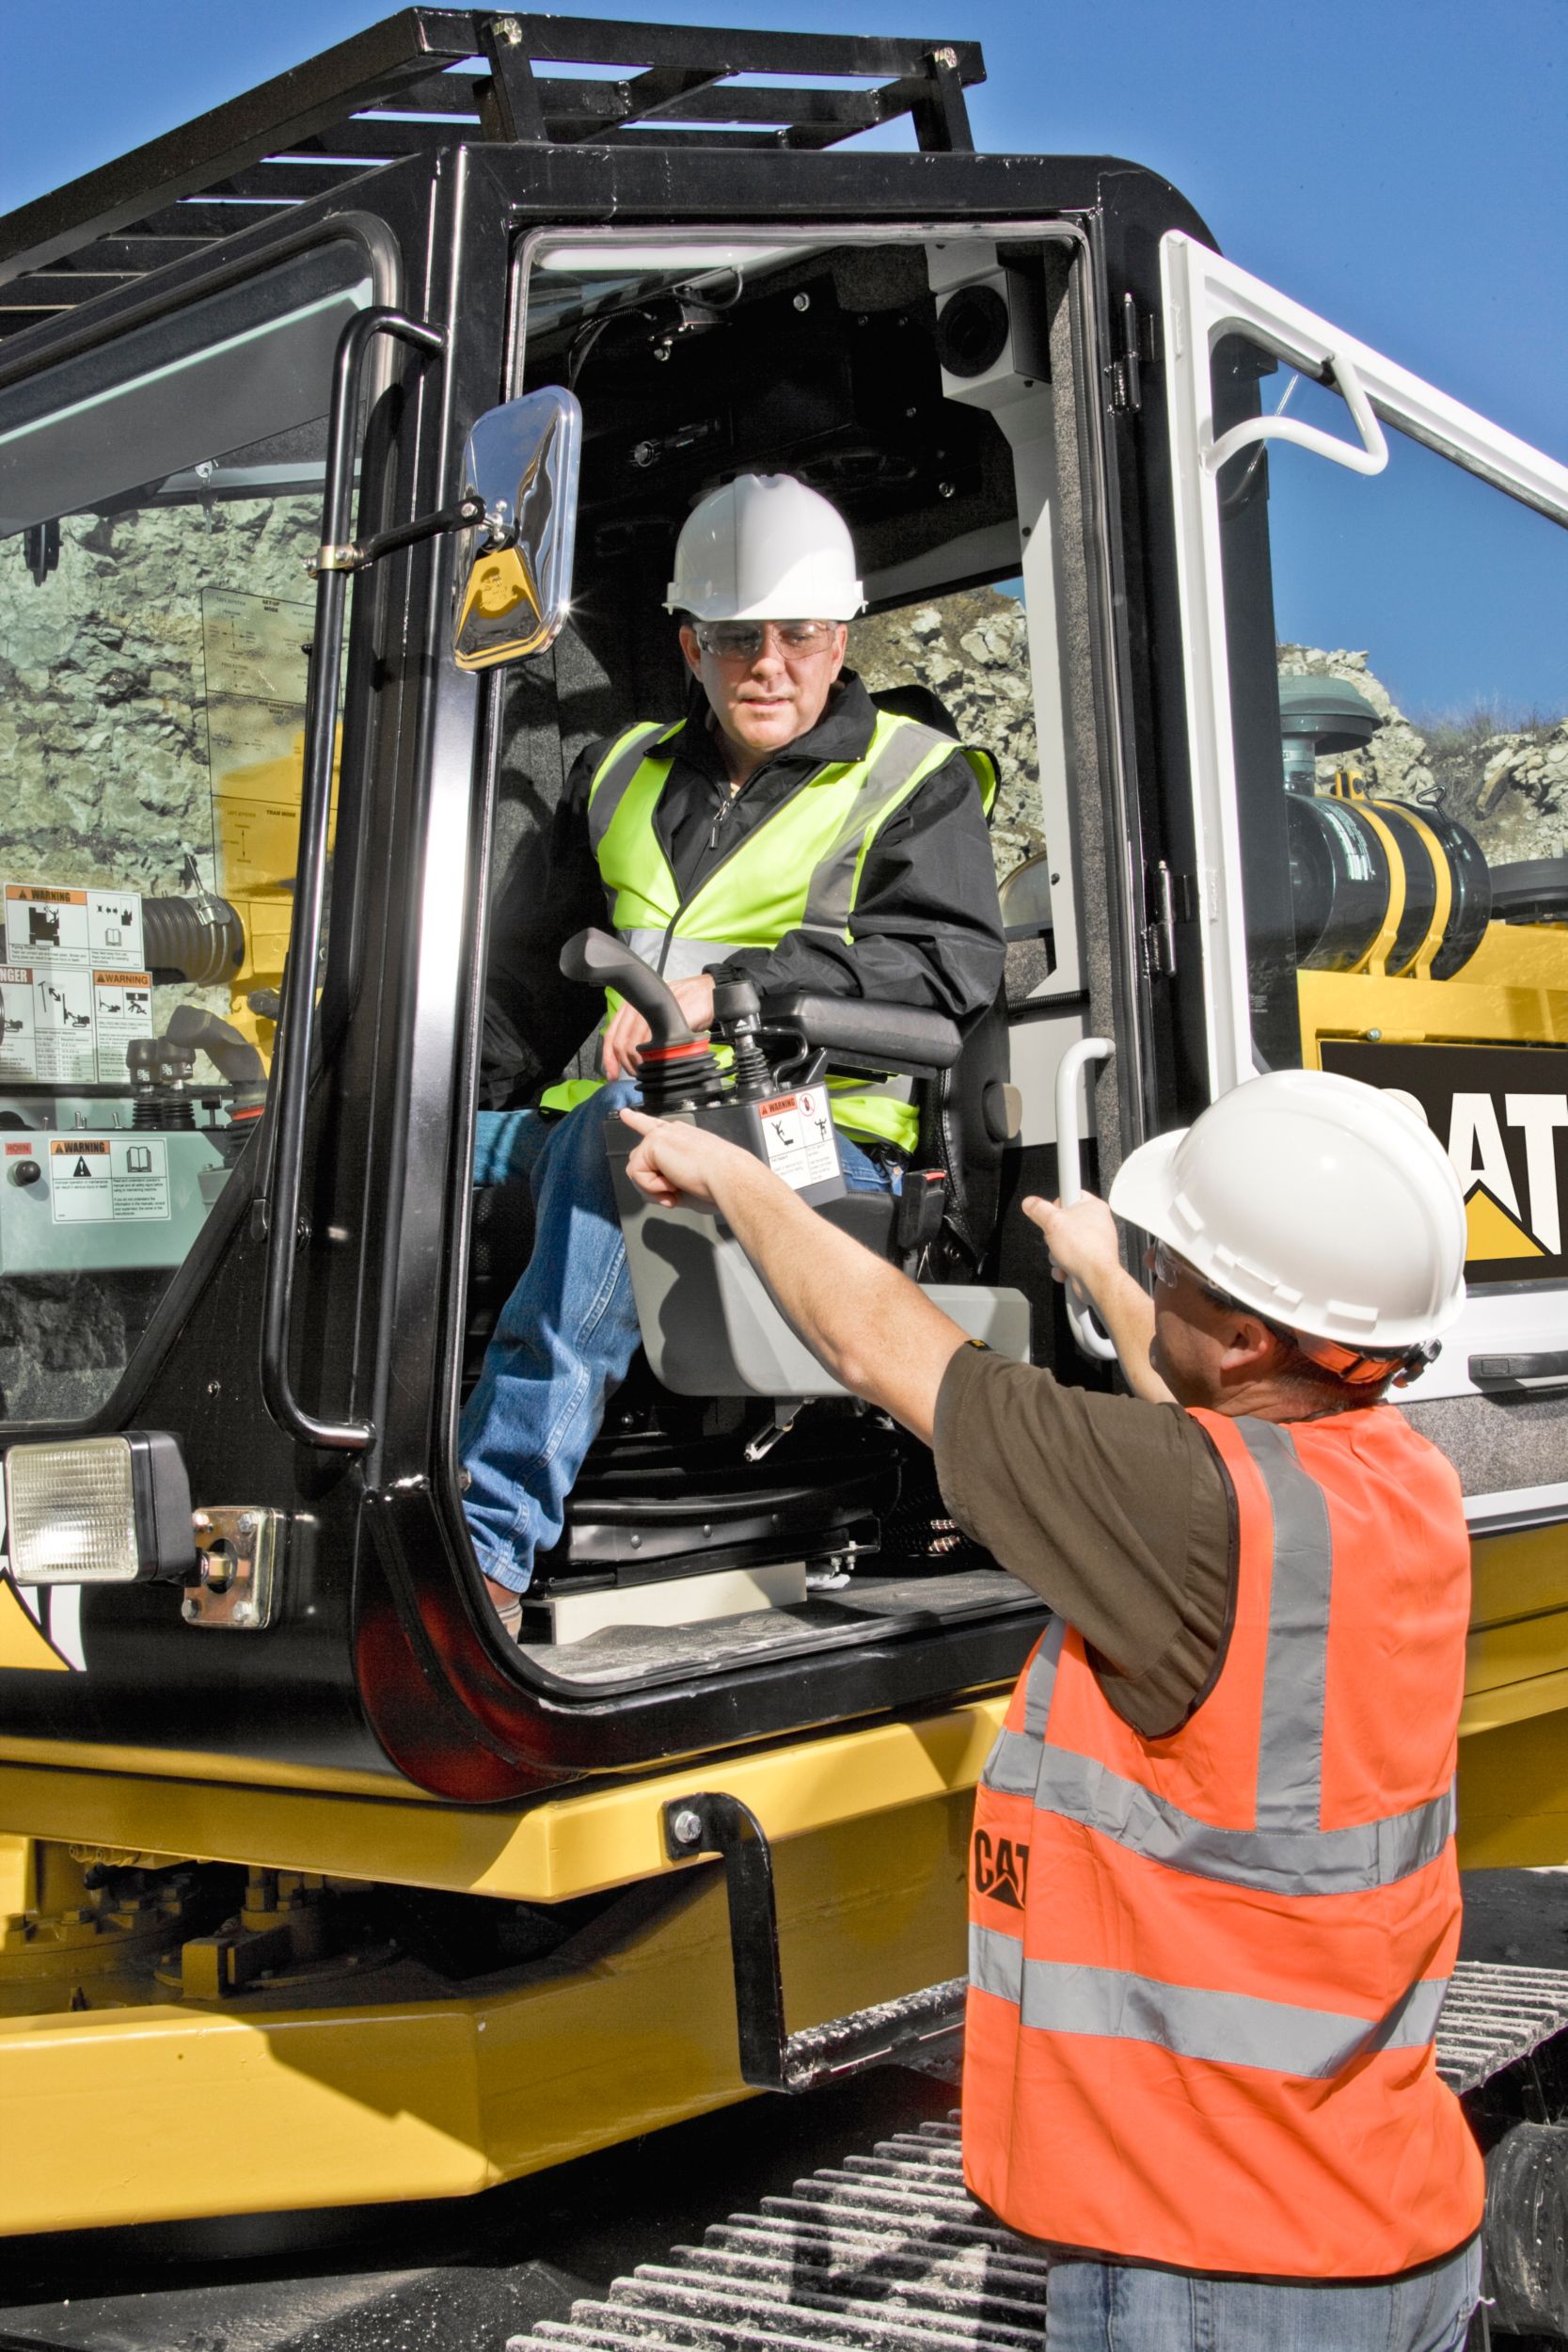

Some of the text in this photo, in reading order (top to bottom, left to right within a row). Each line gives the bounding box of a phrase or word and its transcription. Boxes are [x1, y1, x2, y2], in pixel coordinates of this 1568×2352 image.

[31, 888, 71, 902] WARNING
[0, 968, 27, 982] NGER
[105, 975, 149, 985] WARNING
[768, 1098, 796, 1113] WARNING
[7, 1143, 29, 1152] HORN
[64, 1142, 104, 1153] WARNING
[1380, 1089, 1568, 1255] AT
